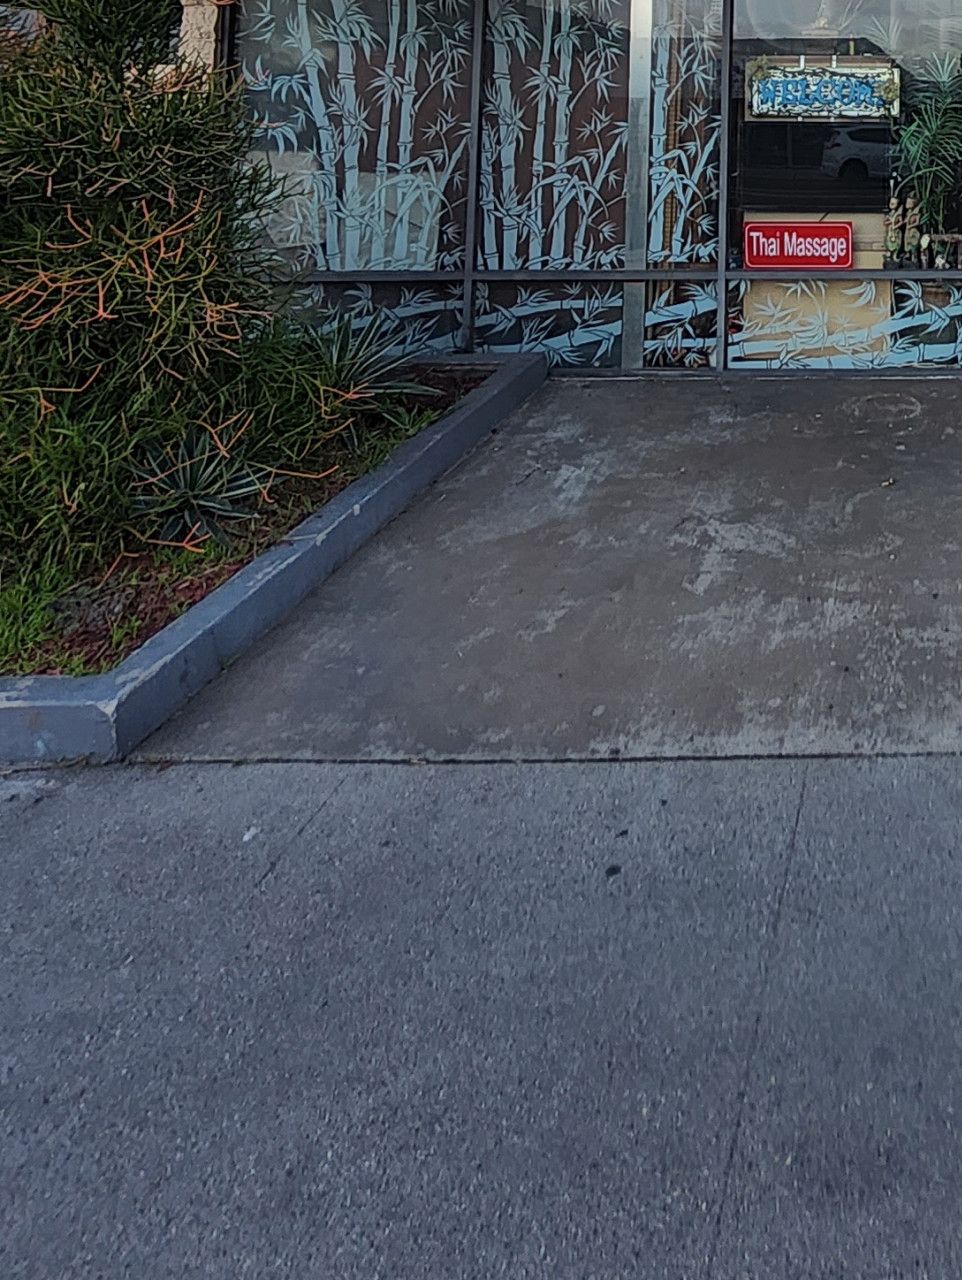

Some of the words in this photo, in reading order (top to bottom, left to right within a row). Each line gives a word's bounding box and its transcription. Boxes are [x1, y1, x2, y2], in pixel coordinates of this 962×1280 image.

[758, 78, 886, 107] WELCOM
[749, 231, 780, 256] Thai
[784, 231, 847, 263] Massage
